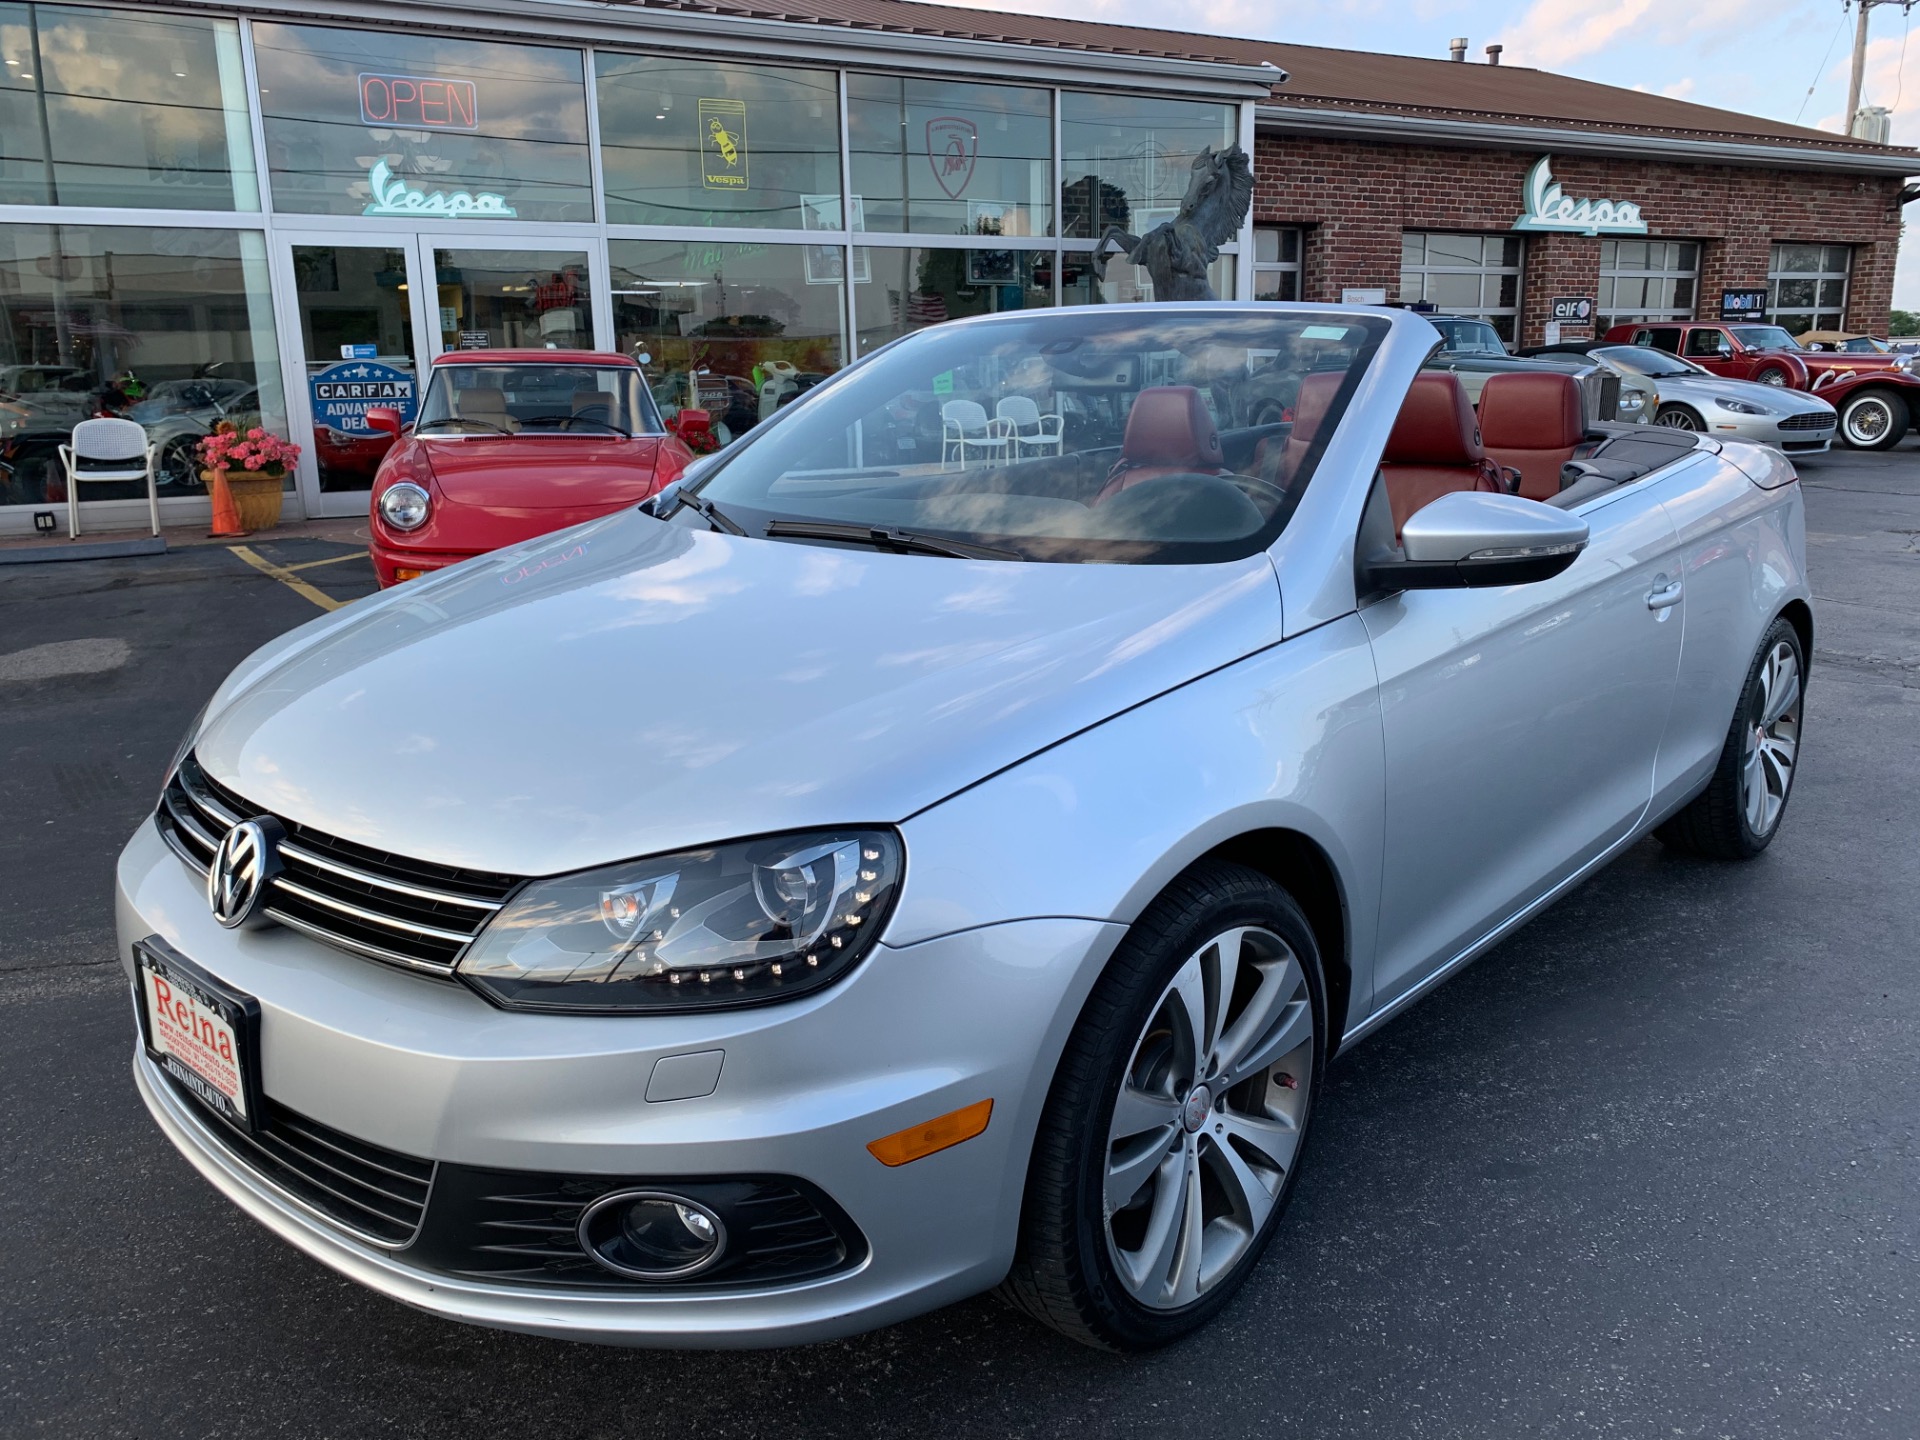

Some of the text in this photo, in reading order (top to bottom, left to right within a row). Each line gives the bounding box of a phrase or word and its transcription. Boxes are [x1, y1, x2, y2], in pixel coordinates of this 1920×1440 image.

[364, 78, 473, 126] OPEN
[367, 157, 516, 218] Vespa
[705, 174, 746, 186] Vespa
[1518, 156, 1646, 234] Vespa
[1346, 294, 1365, 304] Bosch
[1723, 294, 1753, 309] Mobil
[1555, 302, 1578, 317] elf
[318, 383, 409, 399] CARFAX
[341, 416, 370, 430] DEA
[152, 974, 236, 1066] Reina
